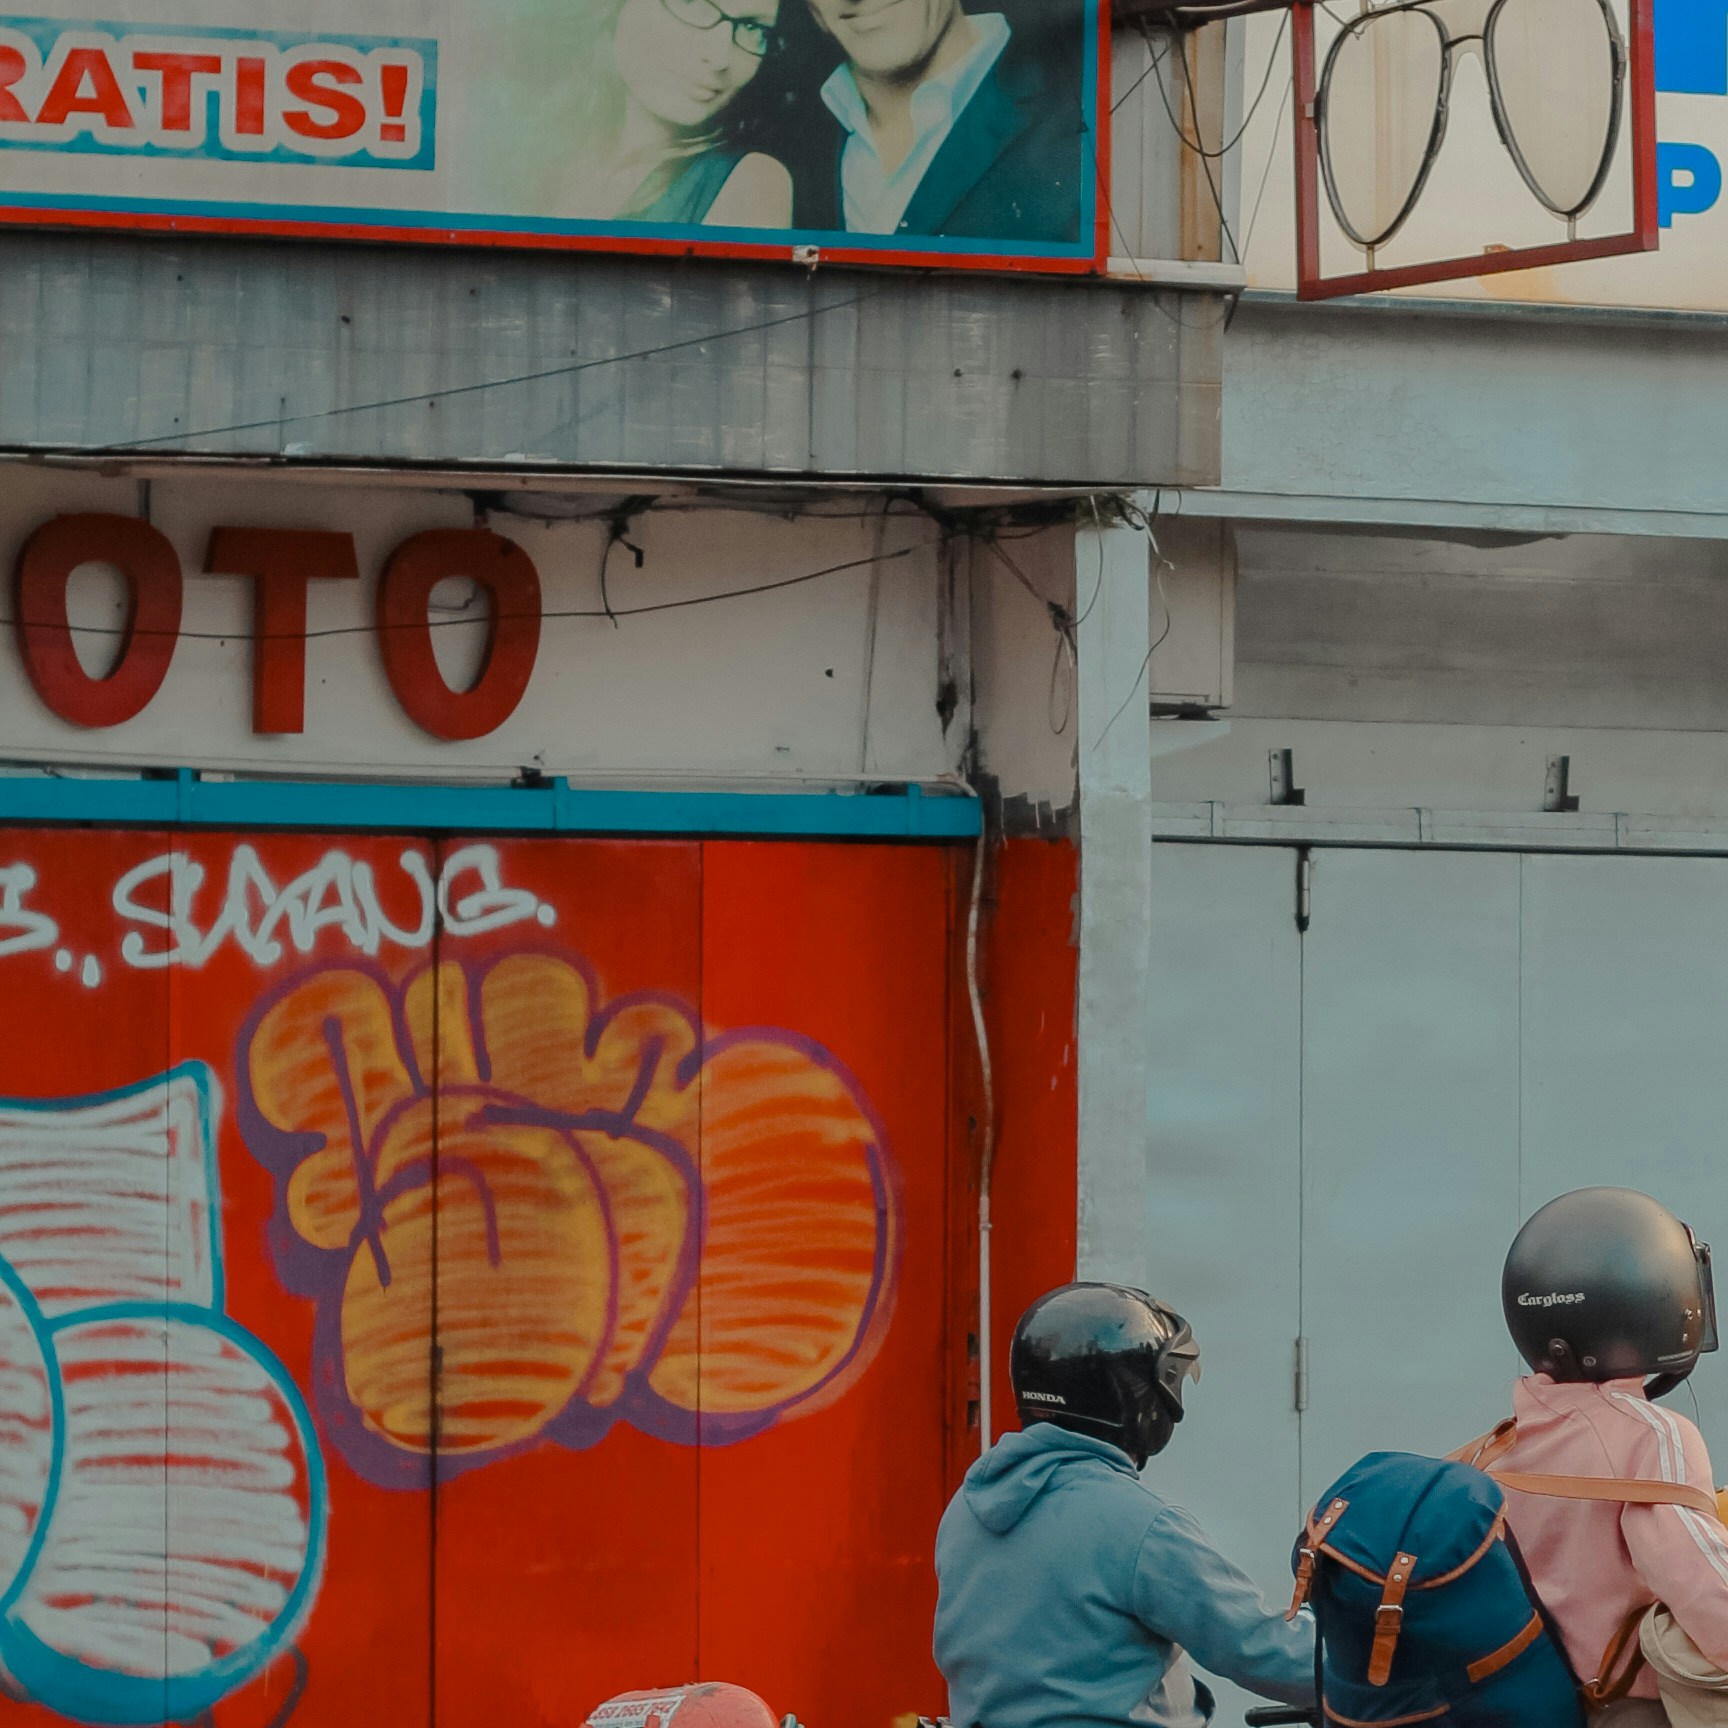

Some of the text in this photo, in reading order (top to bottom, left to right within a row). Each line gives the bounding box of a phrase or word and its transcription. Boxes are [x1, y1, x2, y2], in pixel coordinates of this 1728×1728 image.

[15, 512, 541, 741] OTO
[1517, 1292, 1586, 1308] Cargloss
[1022, 1391, 1066, 1404] HONDA
